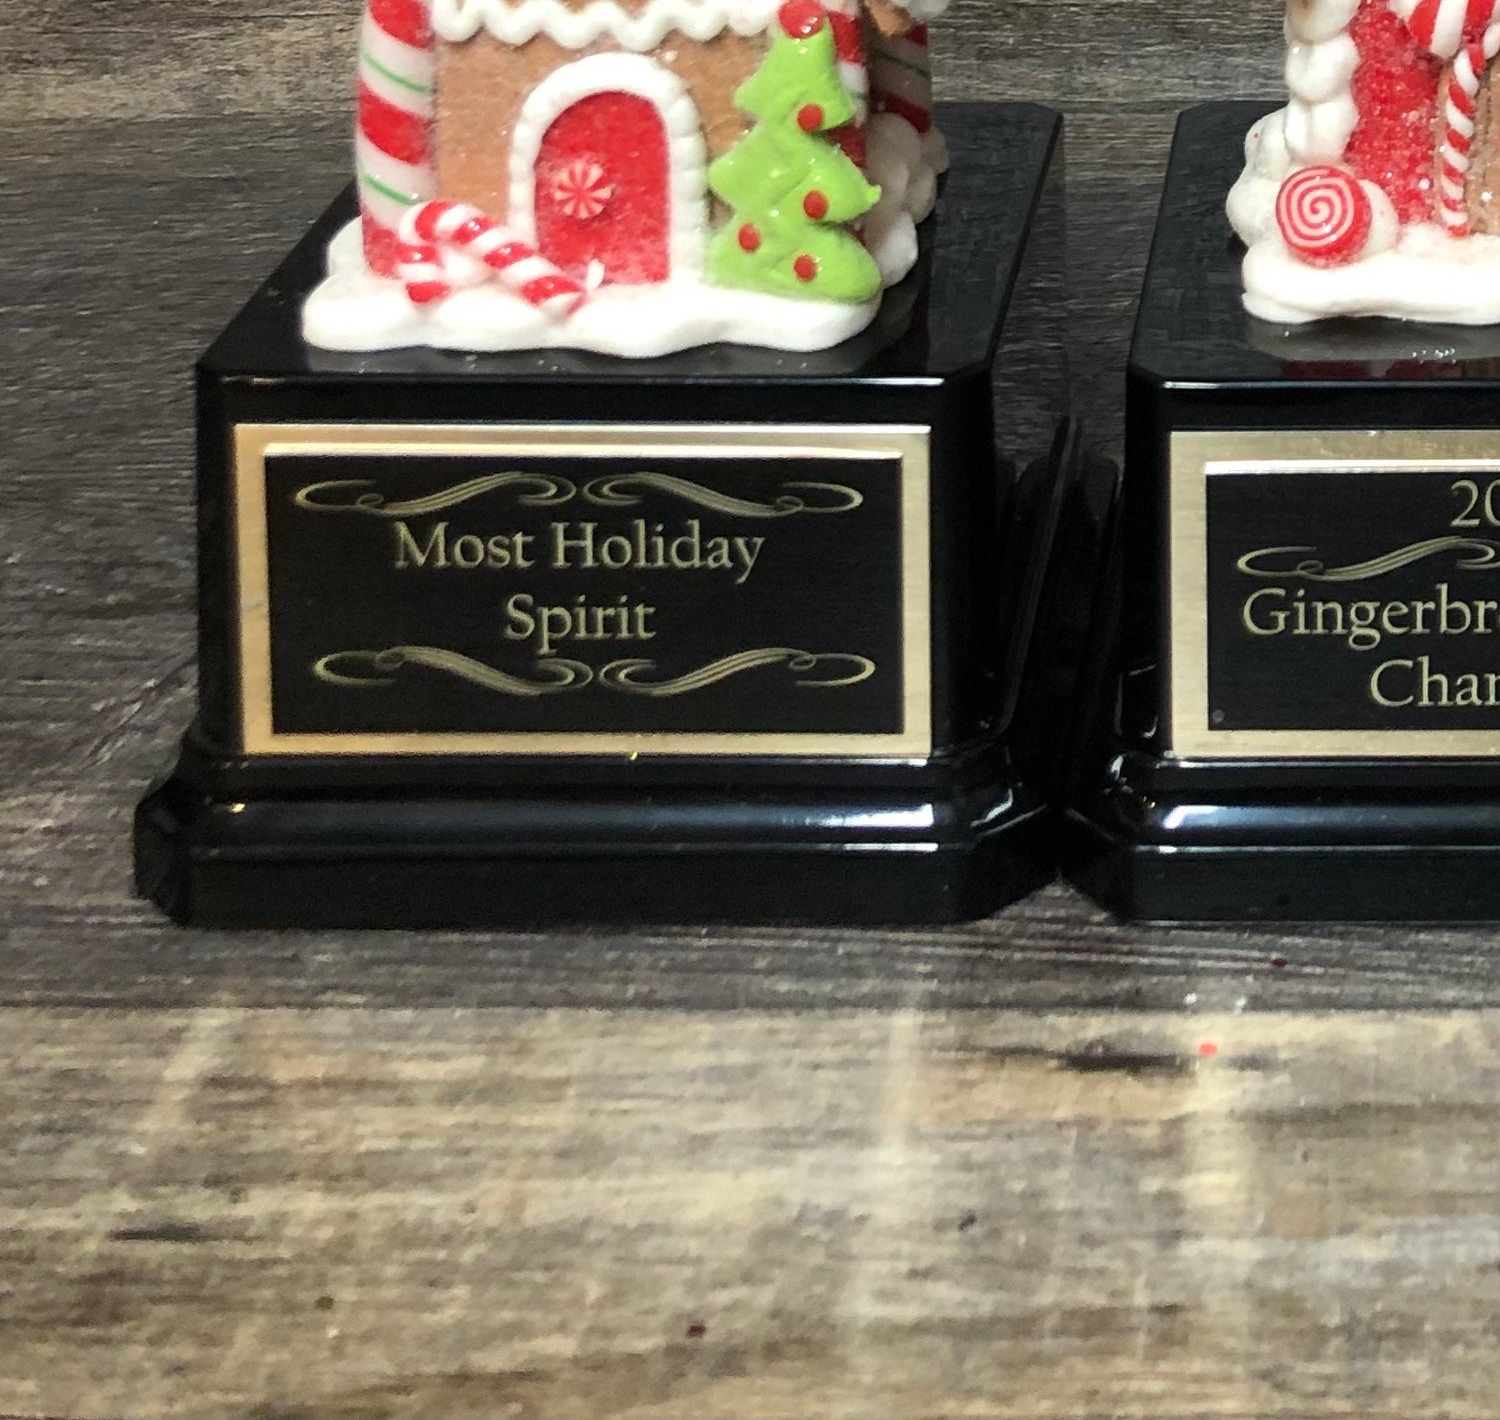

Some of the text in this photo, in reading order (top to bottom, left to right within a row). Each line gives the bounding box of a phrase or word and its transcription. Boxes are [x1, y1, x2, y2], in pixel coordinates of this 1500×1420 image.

[393, 518, 765, 584] Most Holiday
[505, 593, 656, 655] Spirit
